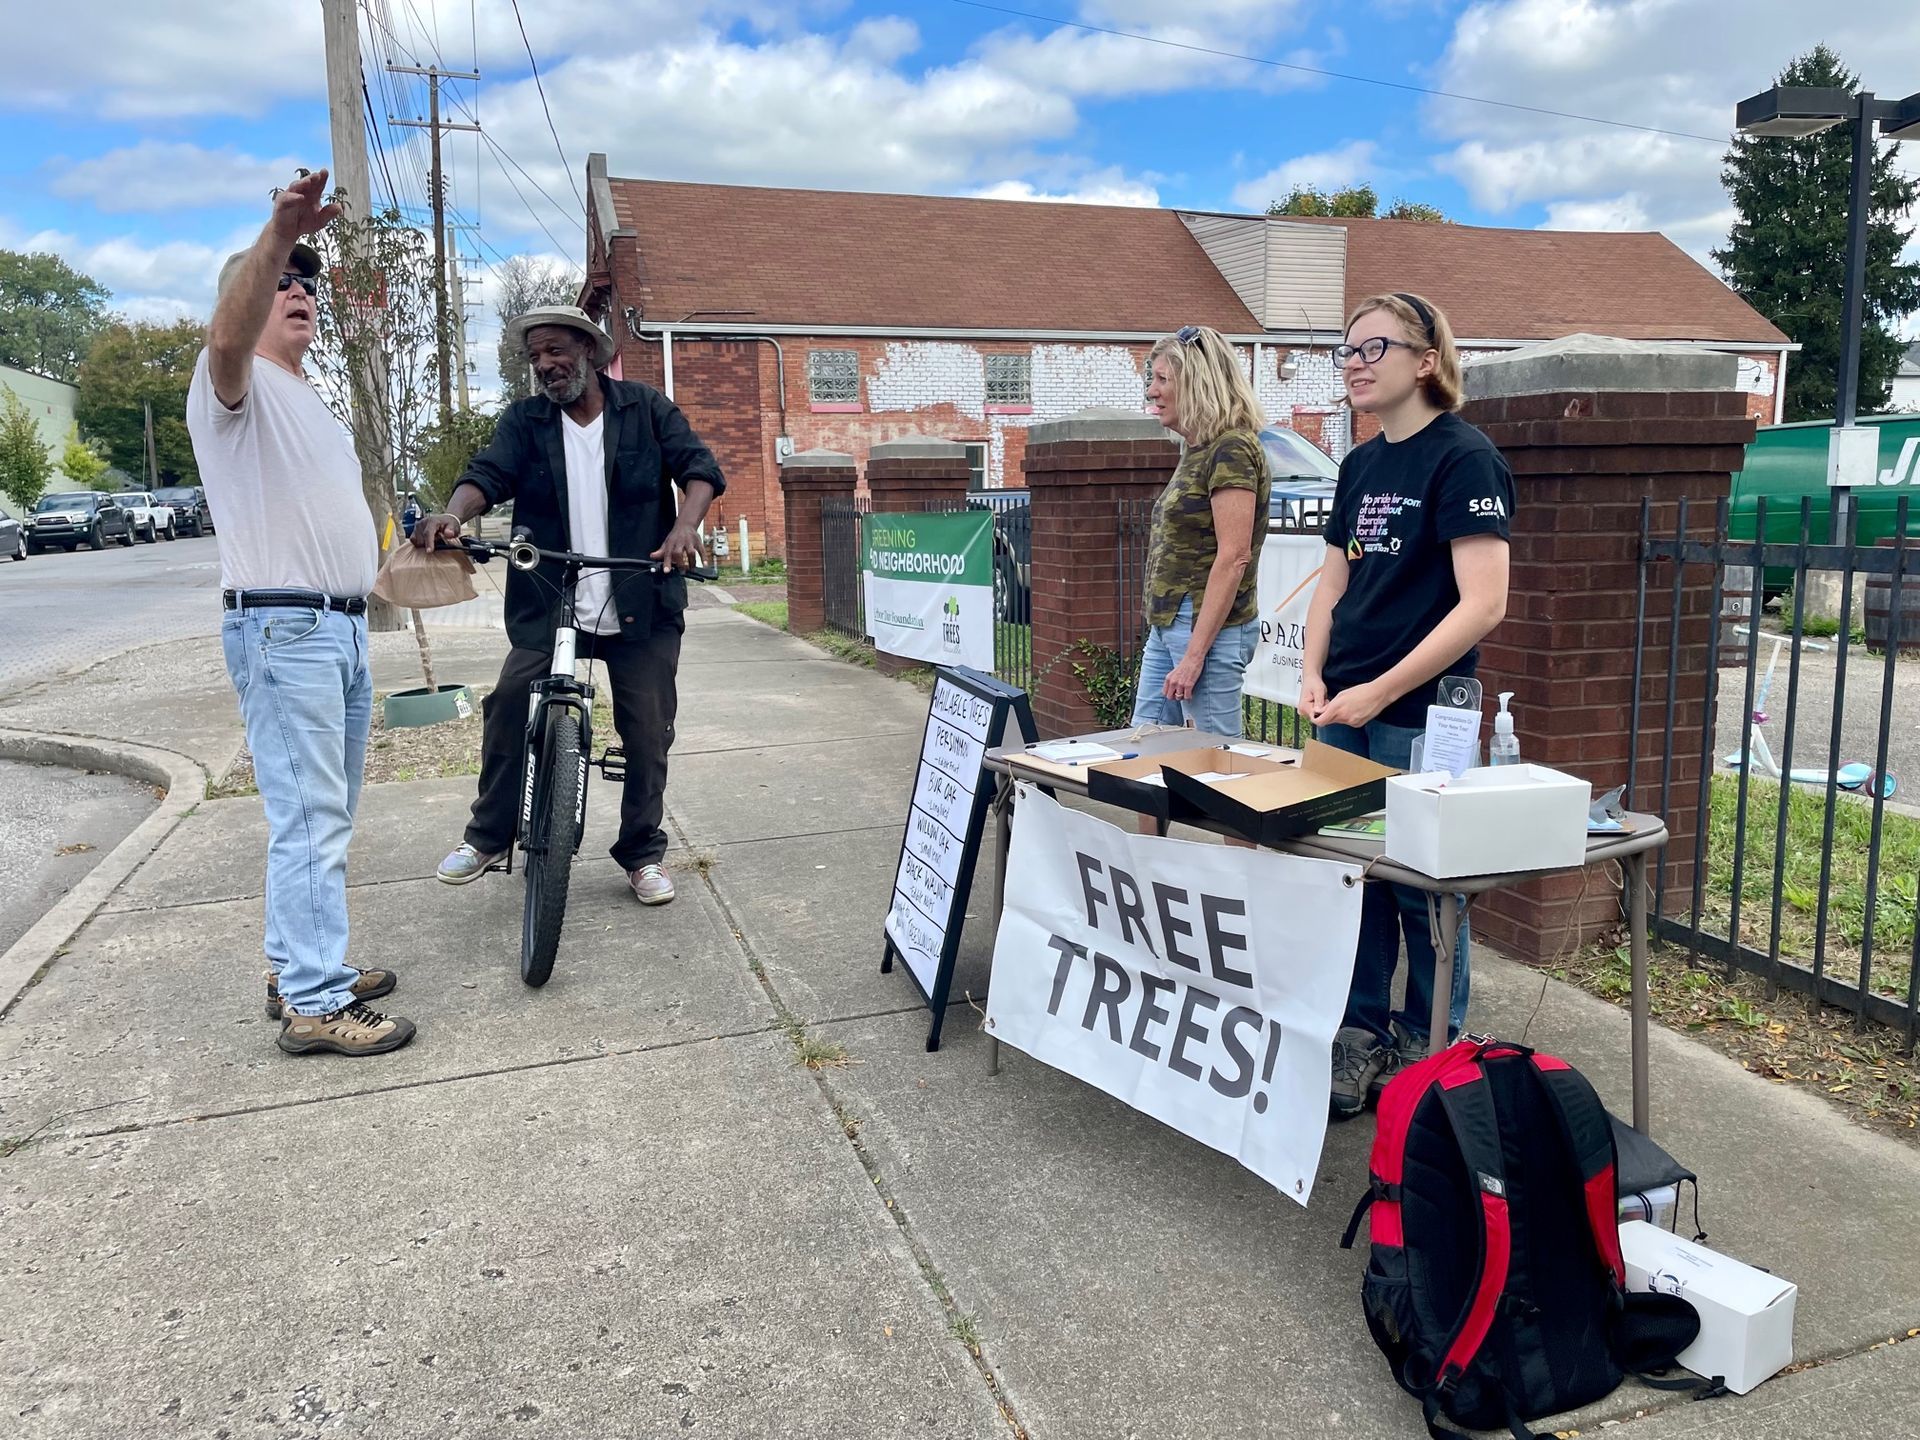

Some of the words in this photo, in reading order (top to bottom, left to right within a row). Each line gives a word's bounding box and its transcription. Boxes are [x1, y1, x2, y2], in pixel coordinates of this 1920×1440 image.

[1359, 504, 1368, 514] of
[1377, 504, 1403, 515] without
[1362, 494, 1373, 504] No
[1372, 493, 1391, 506] pride
[1391, 493, 1403, 504] for
[1469, 496, 1505, 518] SGA
[1356, 525, 1369, 536] for
[1369, 525, 1377, 536] all
[879, 551, 965, 575] NEIGHBORHOOD
[942, 622, 960, 644] TREES
[523, 752, 536, 821] SCHWINN
[575, 756, 586, 824] SCHWINN
[928, 771, 942, 793] BUR
[943, 783, 957, 804] OAK
[917, 814, 940, 841] WILLOW
[938, 831, 950, 854] OAK
[906, 855, 922, 881] BLACK
[924, 870, 948, 903] WALNUT
[1075, 850, 1254, 989] FREE
[1046, 933, 1282, 1115] TREES!
